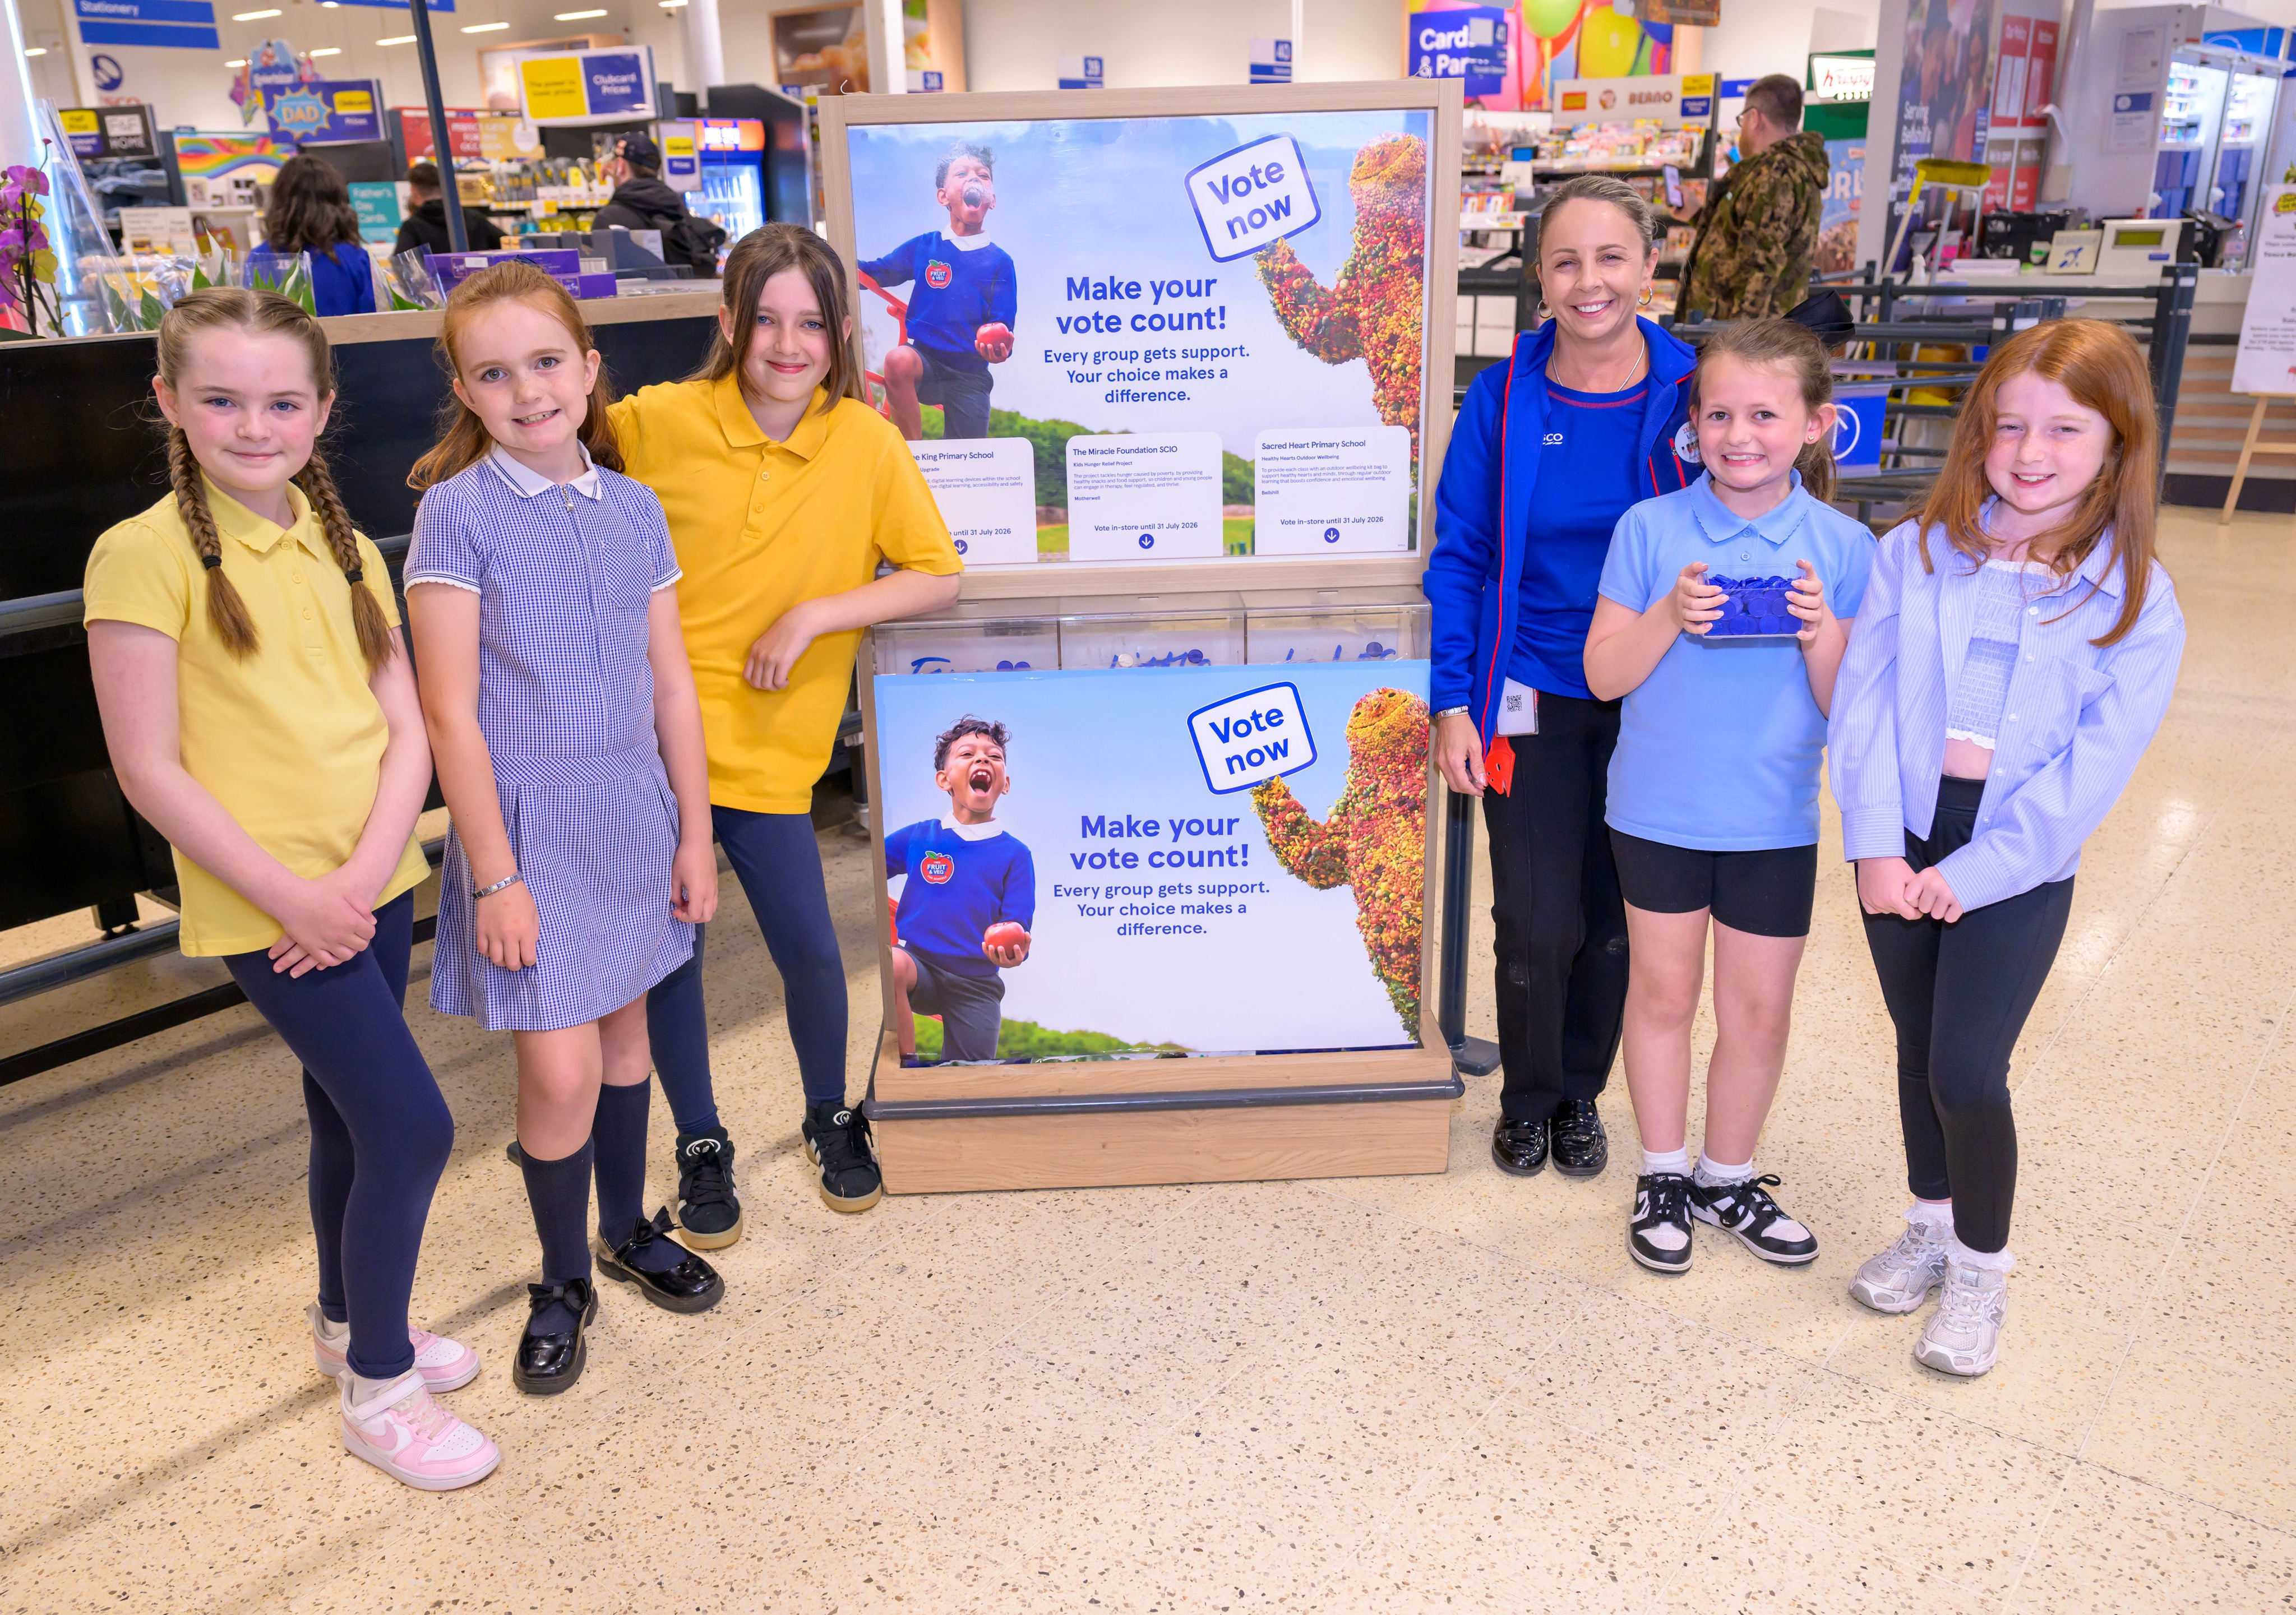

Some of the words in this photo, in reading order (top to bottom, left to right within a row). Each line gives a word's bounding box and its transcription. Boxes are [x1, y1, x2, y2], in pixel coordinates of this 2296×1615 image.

[80, 1, 139, 17] Stationery
[1419, 24, 1476, 52] Card
[593, 72, 637, 85] Clubcard
[601, 84, 631, 95] Prices
[1629, 91, 1673, 105] BEANO
[282, 106, 320, 124] DAD
[353, 187, 394, 198] Father's
[1207, 161, 1286, 206] Vote
[358, 213, 387, 224] Cards
[1226, 194, 1291, 240] now
[1067, 276, 1142, 300] Make
[1150, 279, 1217, 305] your
[1056, 311, 1121, 334] vote
[1131, 306, 1225, 332] count!
[1045, 350, 1088, 365] Every
[1093, 350, 1139, 365] group
[1144, 347, 1176, 363] gets
[1182, 345, 1249, 362] support.
[1067, 371, 1102, 383] Your
[1107, 368, 1160, 382] choice
[1166, 367, 1214, 380] makes
[1220, 369, 1227, 378] a
[1105, 390, 1190, 402] difference.
[1209, 707, 1285, 744] Vote
[1226, 738, 1288, 775] now
[1082, 815, 1159, 838] Make
[1169, 818, 1240, 843] your
[1070, 848, 1139, 869] vote
[1148, 844, 1248, 868] count!
[1054, 885, 1100, 899] Every
[1105, 886, 1153, 899] group
[1158, 883, 1192, 898] gets
[1198, 881, 1269, 897] support.
[1078, 904, 1114, 917] Your
[1120, 903, 1175, 915] choice
[1181, 902, 1232, 914] makes
[1238, 904, 1246, 913] a
[1117, 923, 1207, 936] difference.
